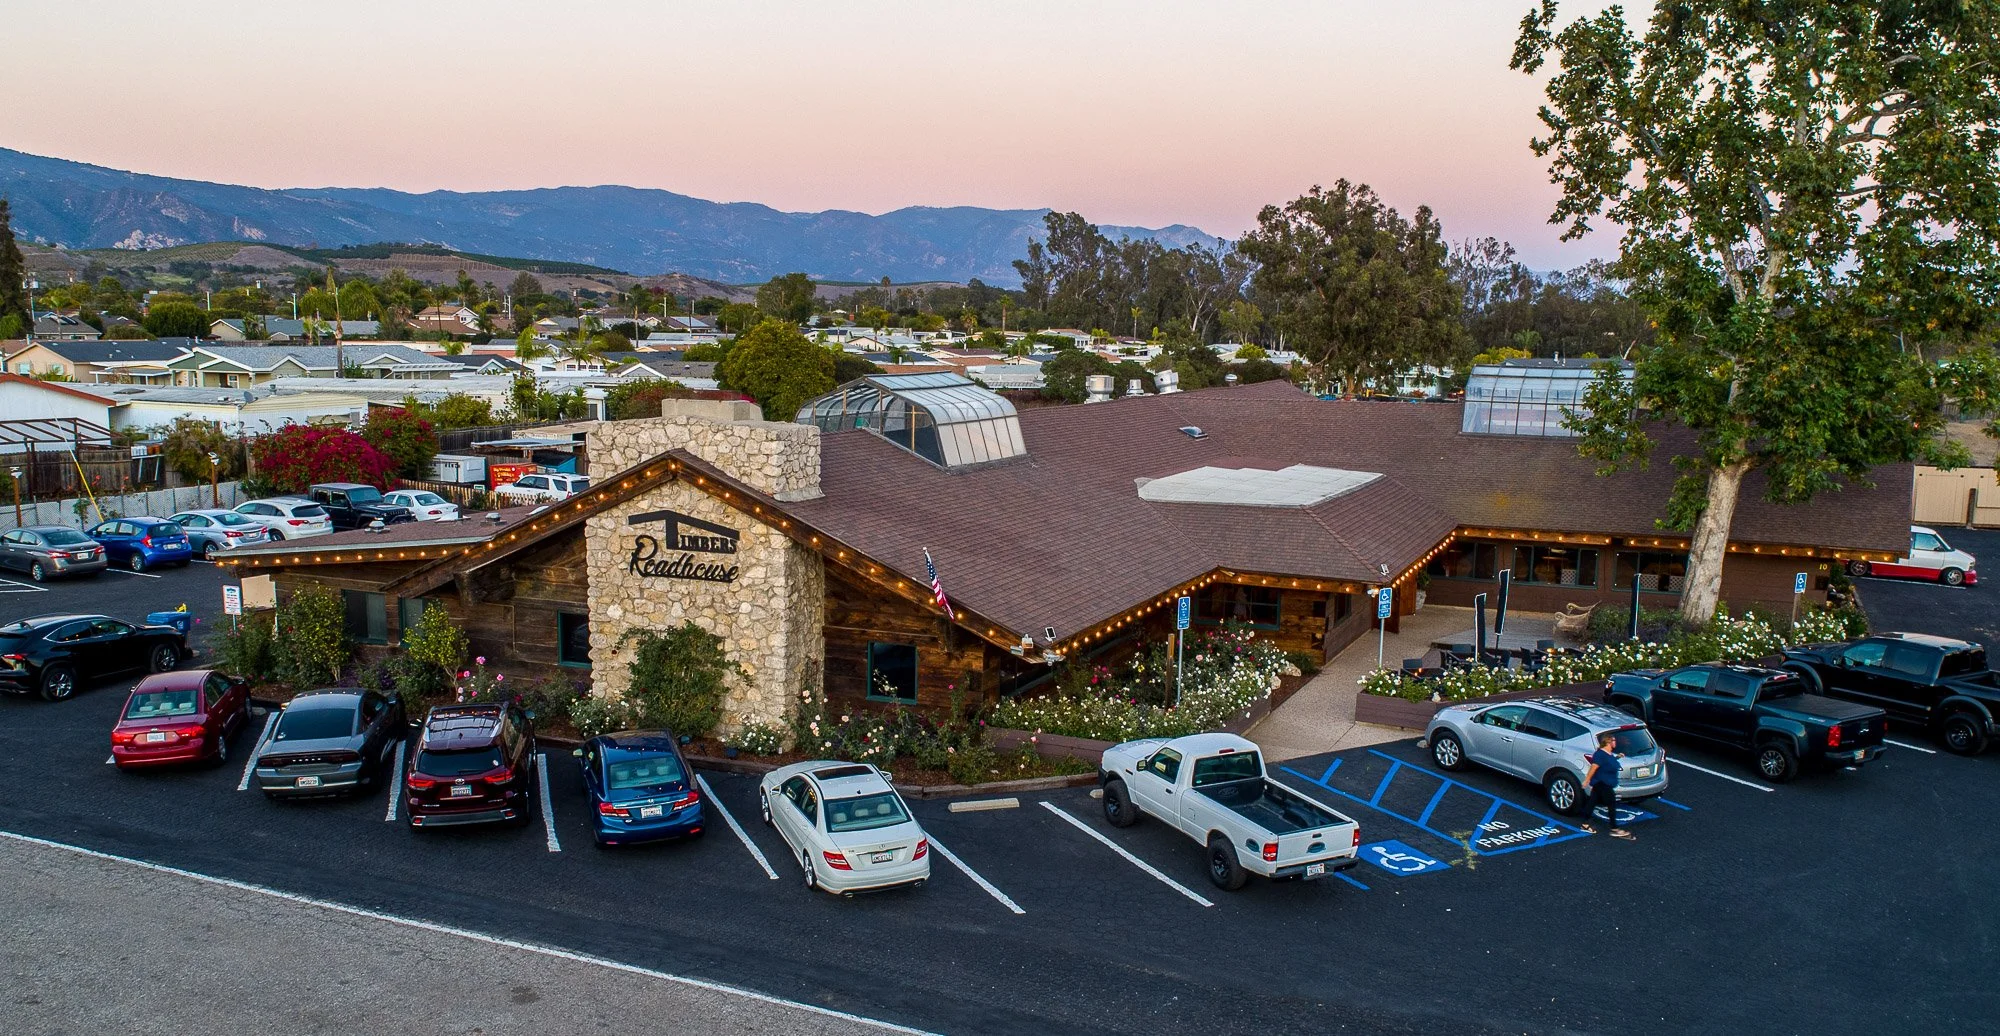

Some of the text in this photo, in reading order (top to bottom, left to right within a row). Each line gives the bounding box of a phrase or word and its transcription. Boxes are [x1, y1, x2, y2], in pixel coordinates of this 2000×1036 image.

[628, 510, 740, 554] TIMBERS
[629, 534, 739, 583] Roadhouse
[1475, 826, 1560, 848] PARKING
[1477, 821, 1510, 832] NO
